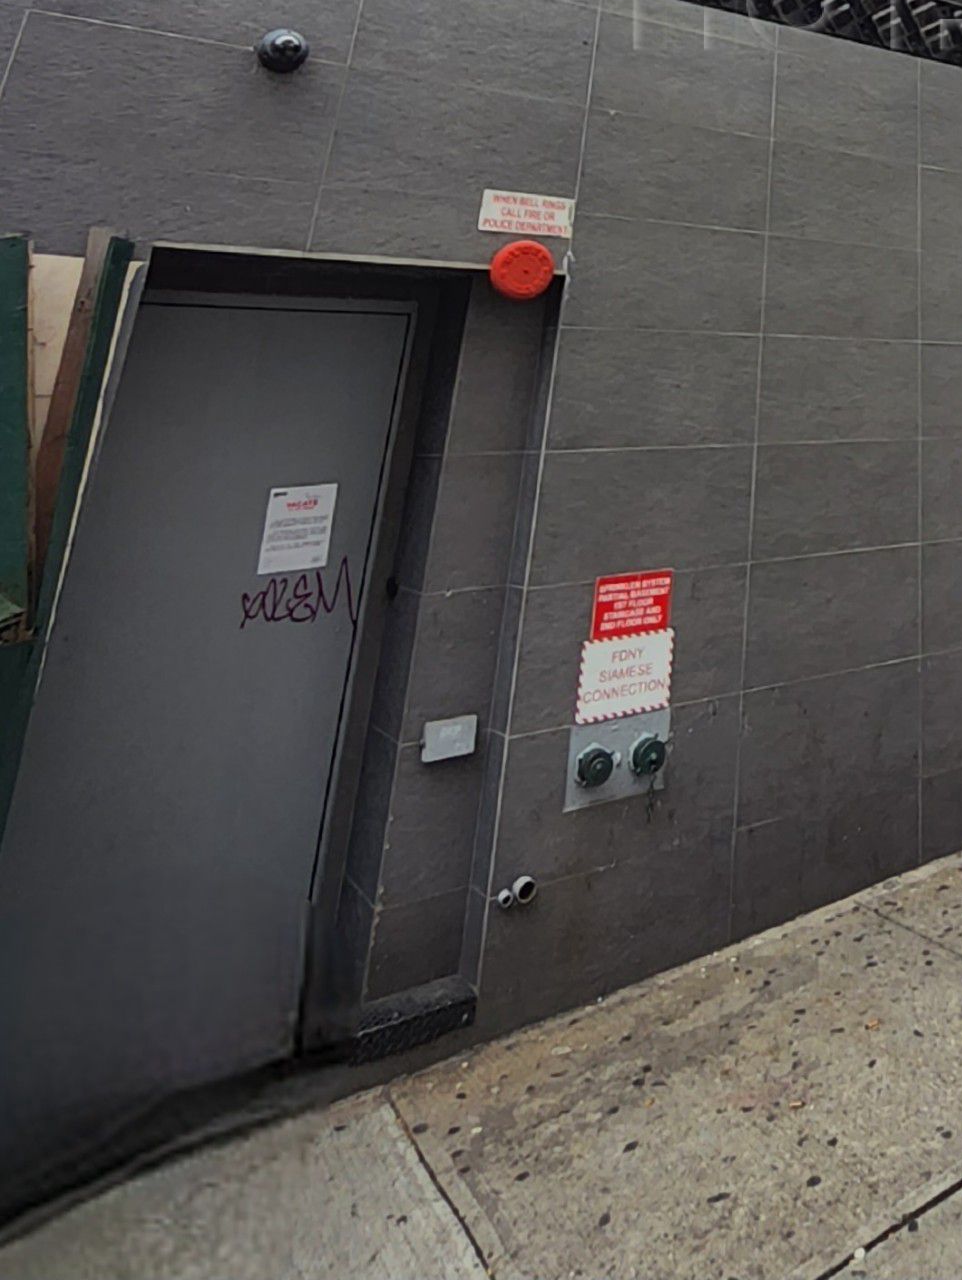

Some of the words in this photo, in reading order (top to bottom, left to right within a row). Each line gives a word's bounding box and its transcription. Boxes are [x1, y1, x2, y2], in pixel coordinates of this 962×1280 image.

[492, 195, 518, 205] WHEN
[519, 197, 538, 207] BELL
[542, 200, 566, 210] RINGS
[501, 207, 521, 218] CALL
[523, 209, 542, 220] FIRE
[544, 211, 555, 221] OR
[483, 218, 513, 230] POLICE
[515, 221, 568, 234] DEPARTMENT
[599, 581, 641, 592] SPRINKLER
[642, 577, 671, 588] SYSTEM
[598, 592, 628, 602] PARTIAL
[630, 586, 670, 598] BASEMENT
[628, 597, 654, 608] FLOOR
[603, 608, 644, 621] STAIRCASE
[646, 606, 662, 616] AND
[616, 618, 642, 628] FLOOR
[643, 614, 663, 625] ONLY
[611, 646, 646, 663] FDNY
[598, 662, 653, 683] SIAMESE
[583, 678, 666, 704] CONNECTION
